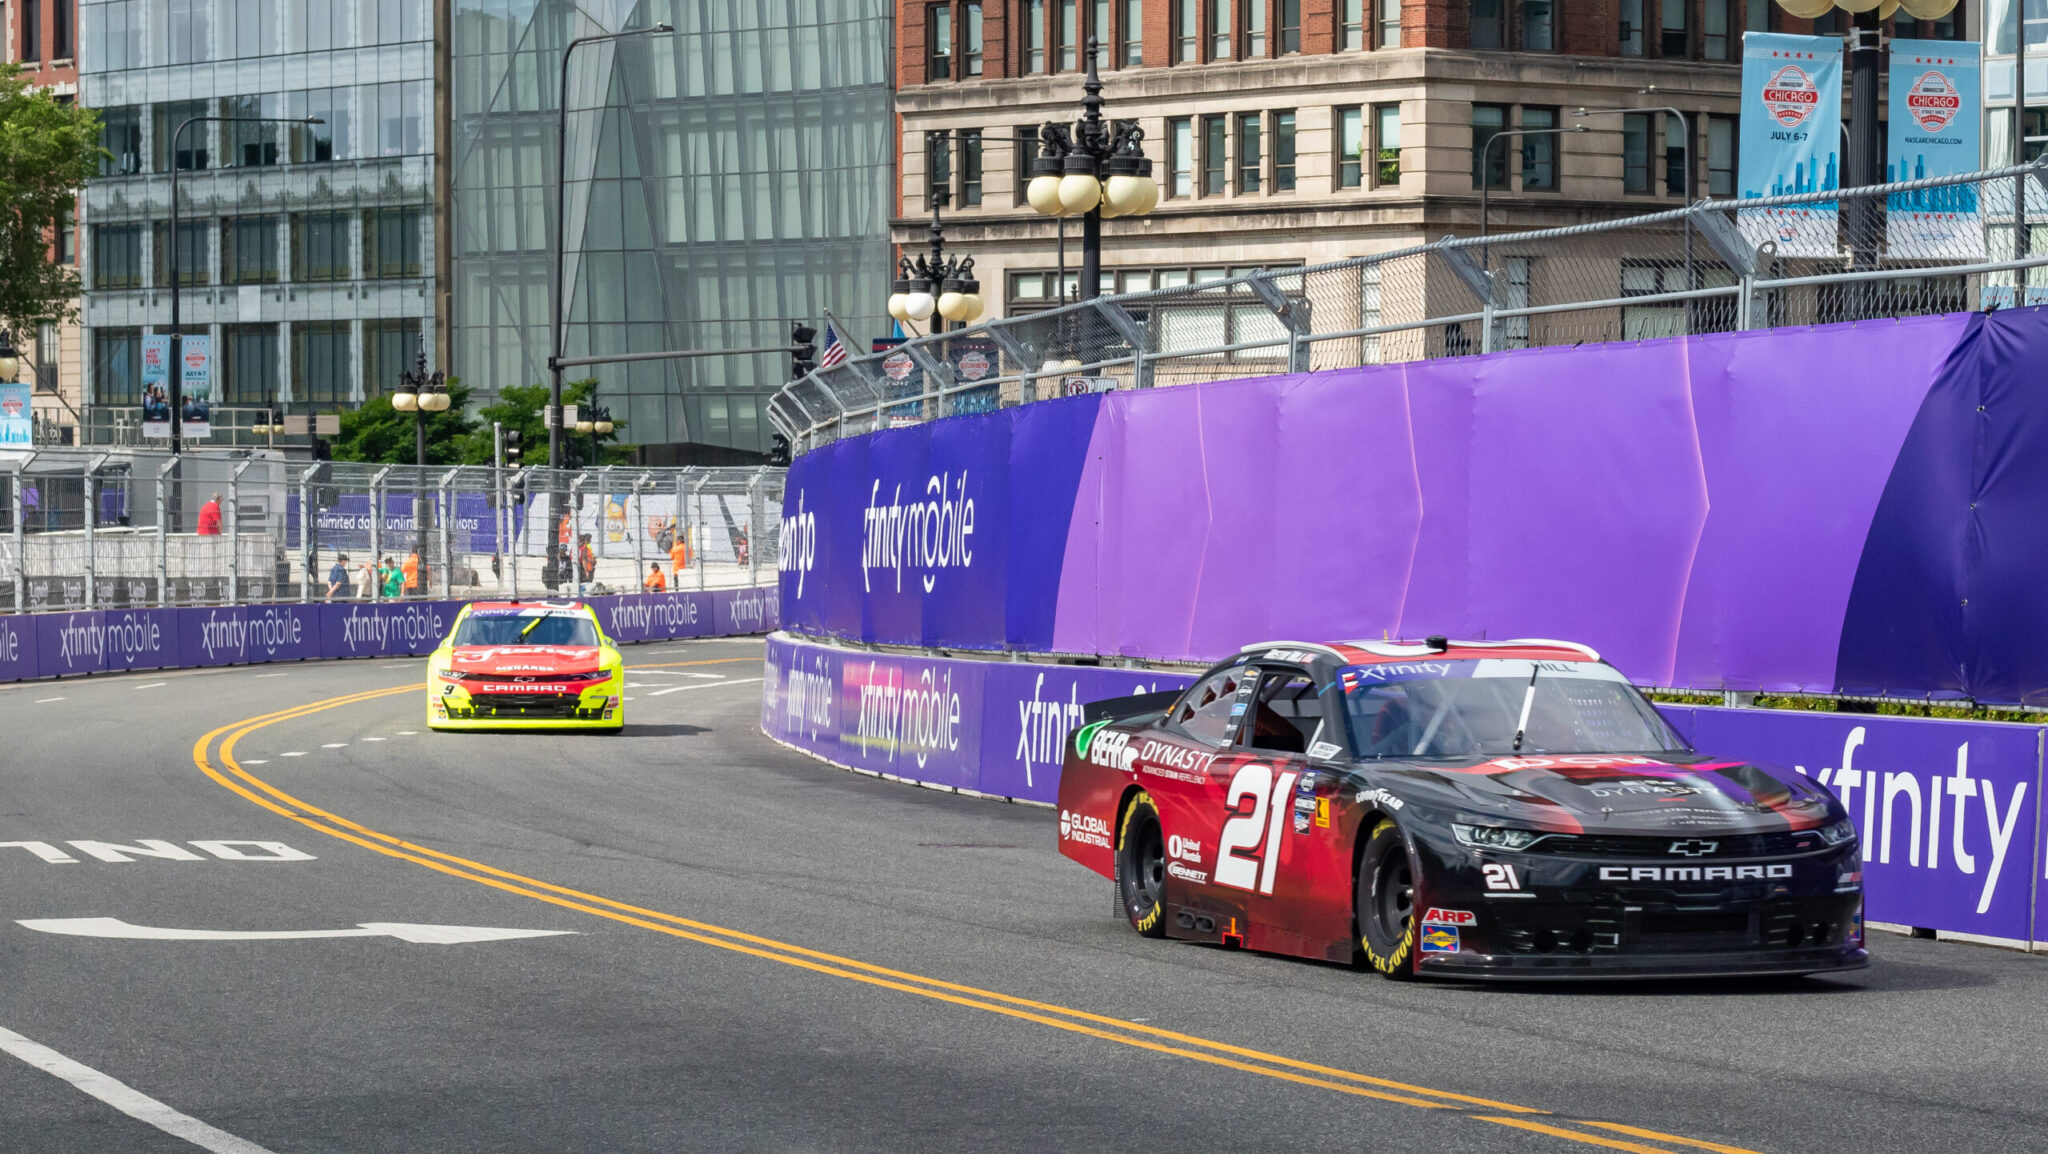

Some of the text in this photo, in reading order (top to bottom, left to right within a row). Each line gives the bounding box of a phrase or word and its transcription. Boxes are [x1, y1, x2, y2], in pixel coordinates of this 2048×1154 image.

[1768, 90, 1813, 102] CHICAGO
[1912, 96, 1955, 107] CHICAGO
[1770, 131, 1808, 142] JULY 6-7
[1904, 137, 1963, 145] NASCARCHICAGO.COM
[610, 597, 651, 637] xfinity
[730, 591, 764, 629] xfinity
[202, 609, 248, 660] xfinity
[343, 605, 388, 651] xfinity
[60, 614, 106, 668] xfinity
[1358, 662, 1452, 681] xfinity
[443, 684, 456, 695] 9
[482, 684, 567, 692] CAMARO
[857, 660, 901, 763] xfinity
[1091, 729, 1131, 770] BEHR
[1140, 740, 1223, 773] DYNASTY
[1355, 788, 1404, 811] GOODYEAR
[1071, 813, 1111, 836] GLOBAL
[1214, 764, 1297, 895] 21
[1071, 830, 1111, 849] INDUSTRIAL
[1172, 865, 1208, 881] BENNETT
[1482, 864, 1520, 890] 21
[1599, 864, 1793, 882] CAMARO
[1137, 900, 1162, 932] EAGLE
[1425, 909, 1473, 923] ARP
